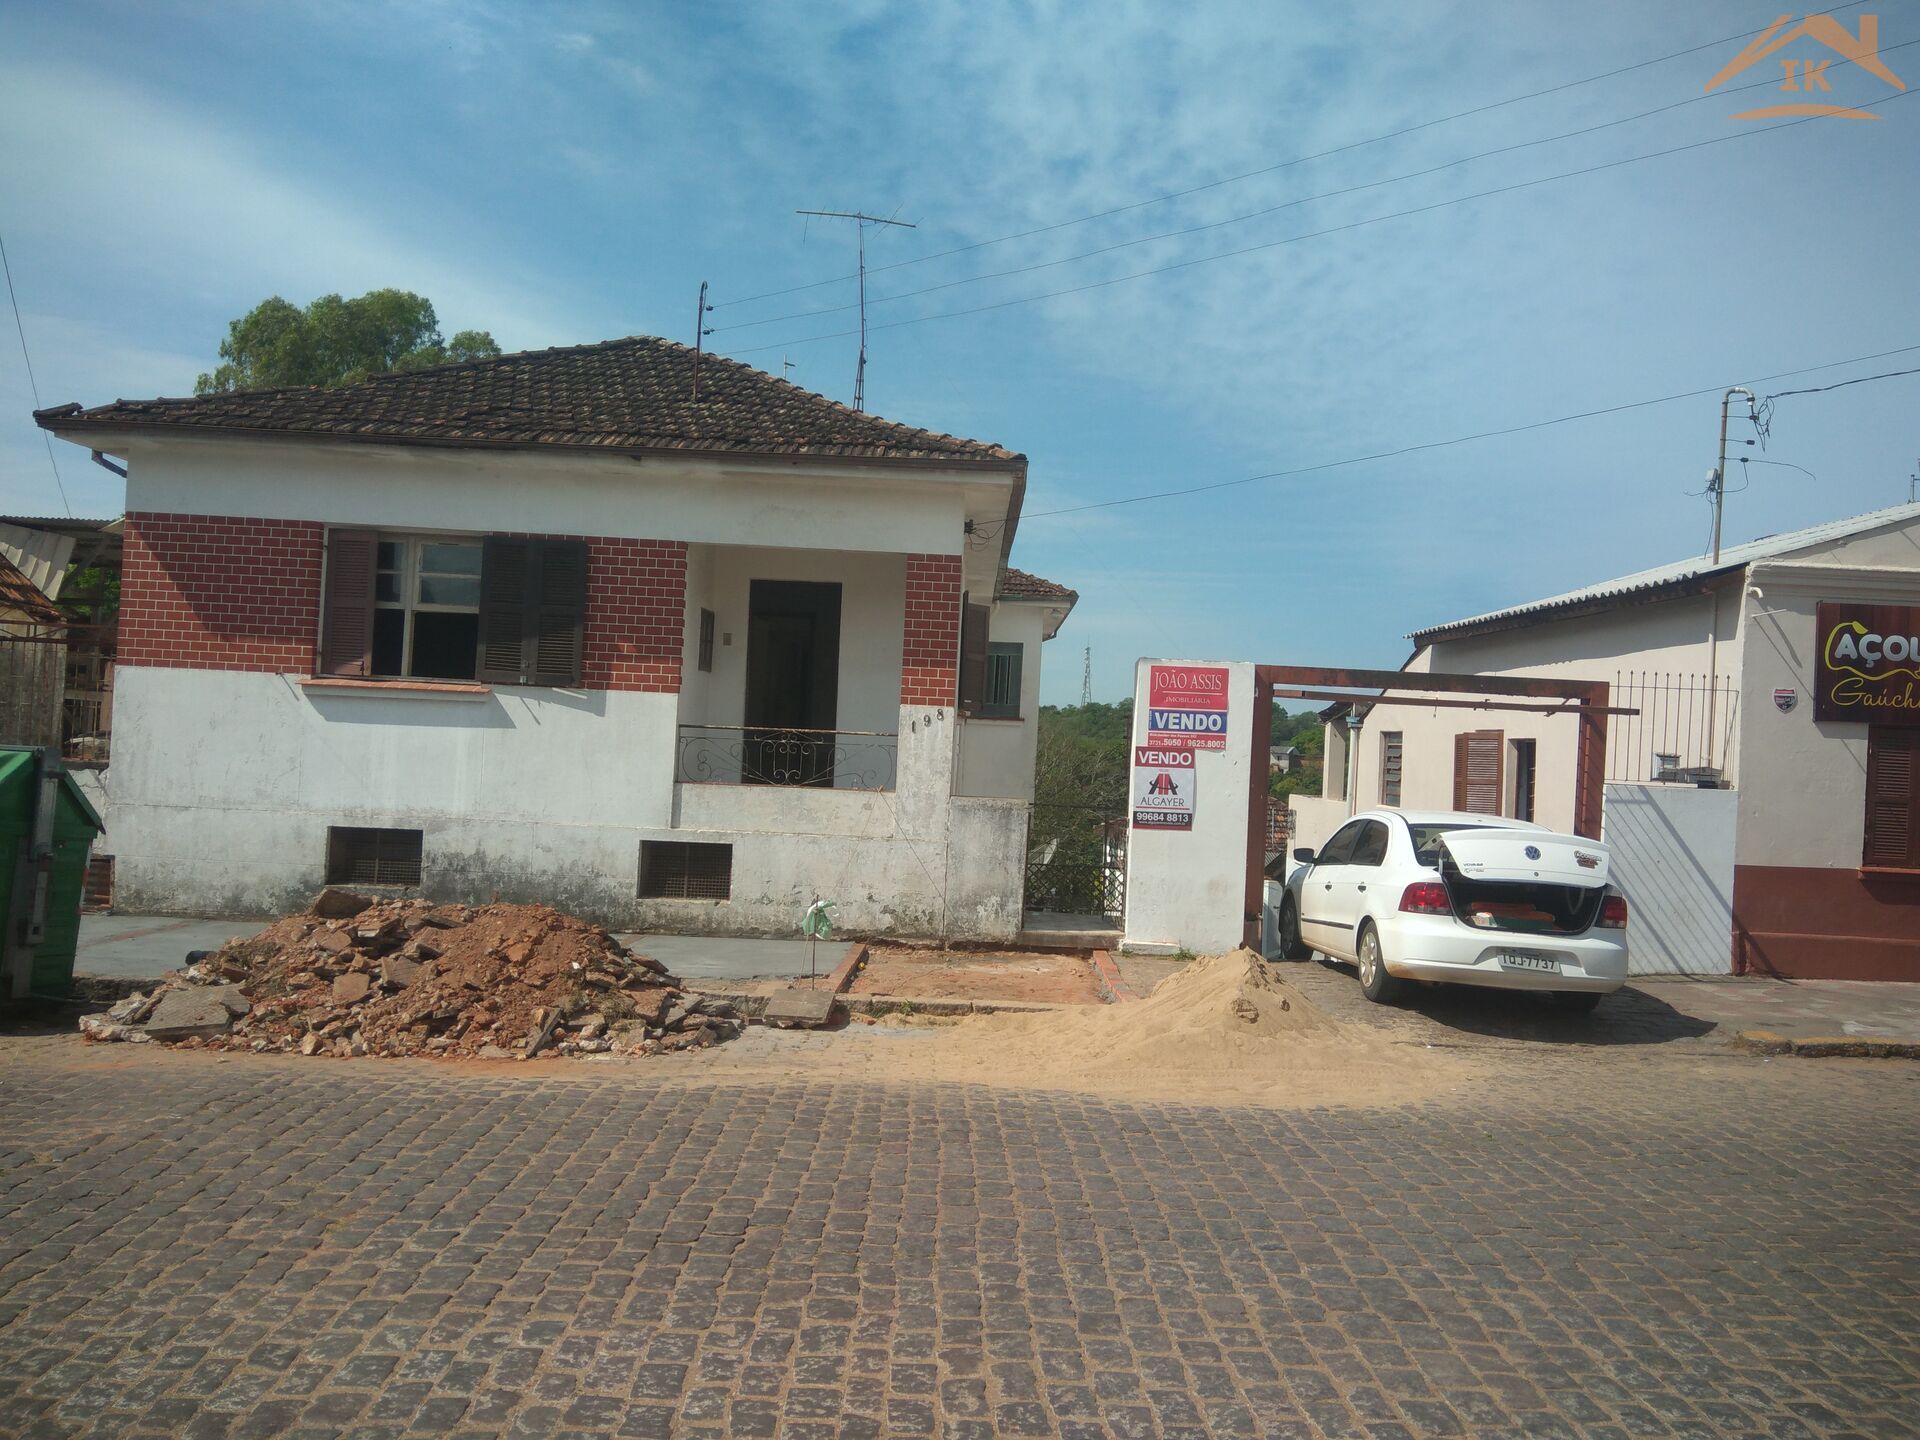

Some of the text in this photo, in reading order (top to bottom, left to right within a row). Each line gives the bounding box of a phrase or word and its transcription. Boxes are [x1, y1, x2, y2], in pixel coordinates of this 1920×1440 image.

[1154, 669, 1222, 692] JOÃO ASSIS
[1831, 677, 1920, 709] Gaúch
[911, 708, 945, 734] 198
[1154, 712, 1222, 731] VENDO
[1138, 751, 1192, 766] VENDO
[1140, 796, 1185, 807] ALGAYER
[1136, 812, 1164, 822] 99684
[1166, 813, 1189, 823] 8813
